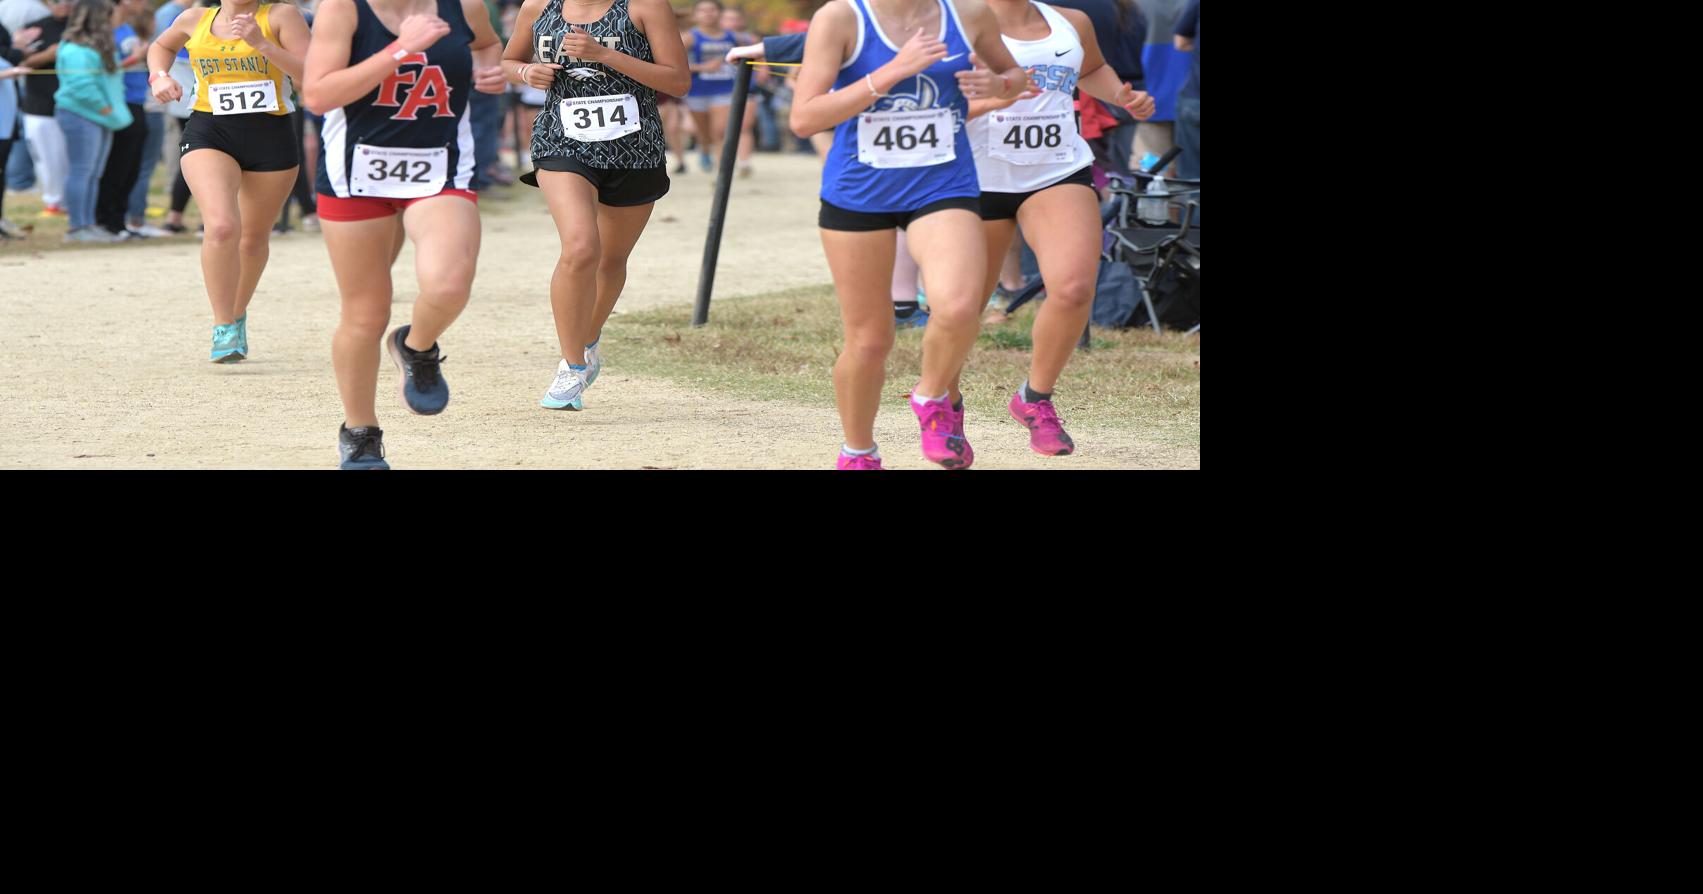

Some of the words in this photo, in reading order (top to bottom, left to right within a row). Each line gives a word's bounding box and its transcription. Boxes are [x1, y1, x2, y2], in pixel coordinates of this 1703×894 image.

[195, 58, 221, 78] EST
[224, 55, 270, 75] STANLY
[372, 51, 456, 120] FA
[219, 90, 267, 111] 512
[573, 105, 628, 130] 314
[873, 123, 939, 151] 464
[1003, 124, 1062, 149] 408
[367, 159, 432, 183] 342
